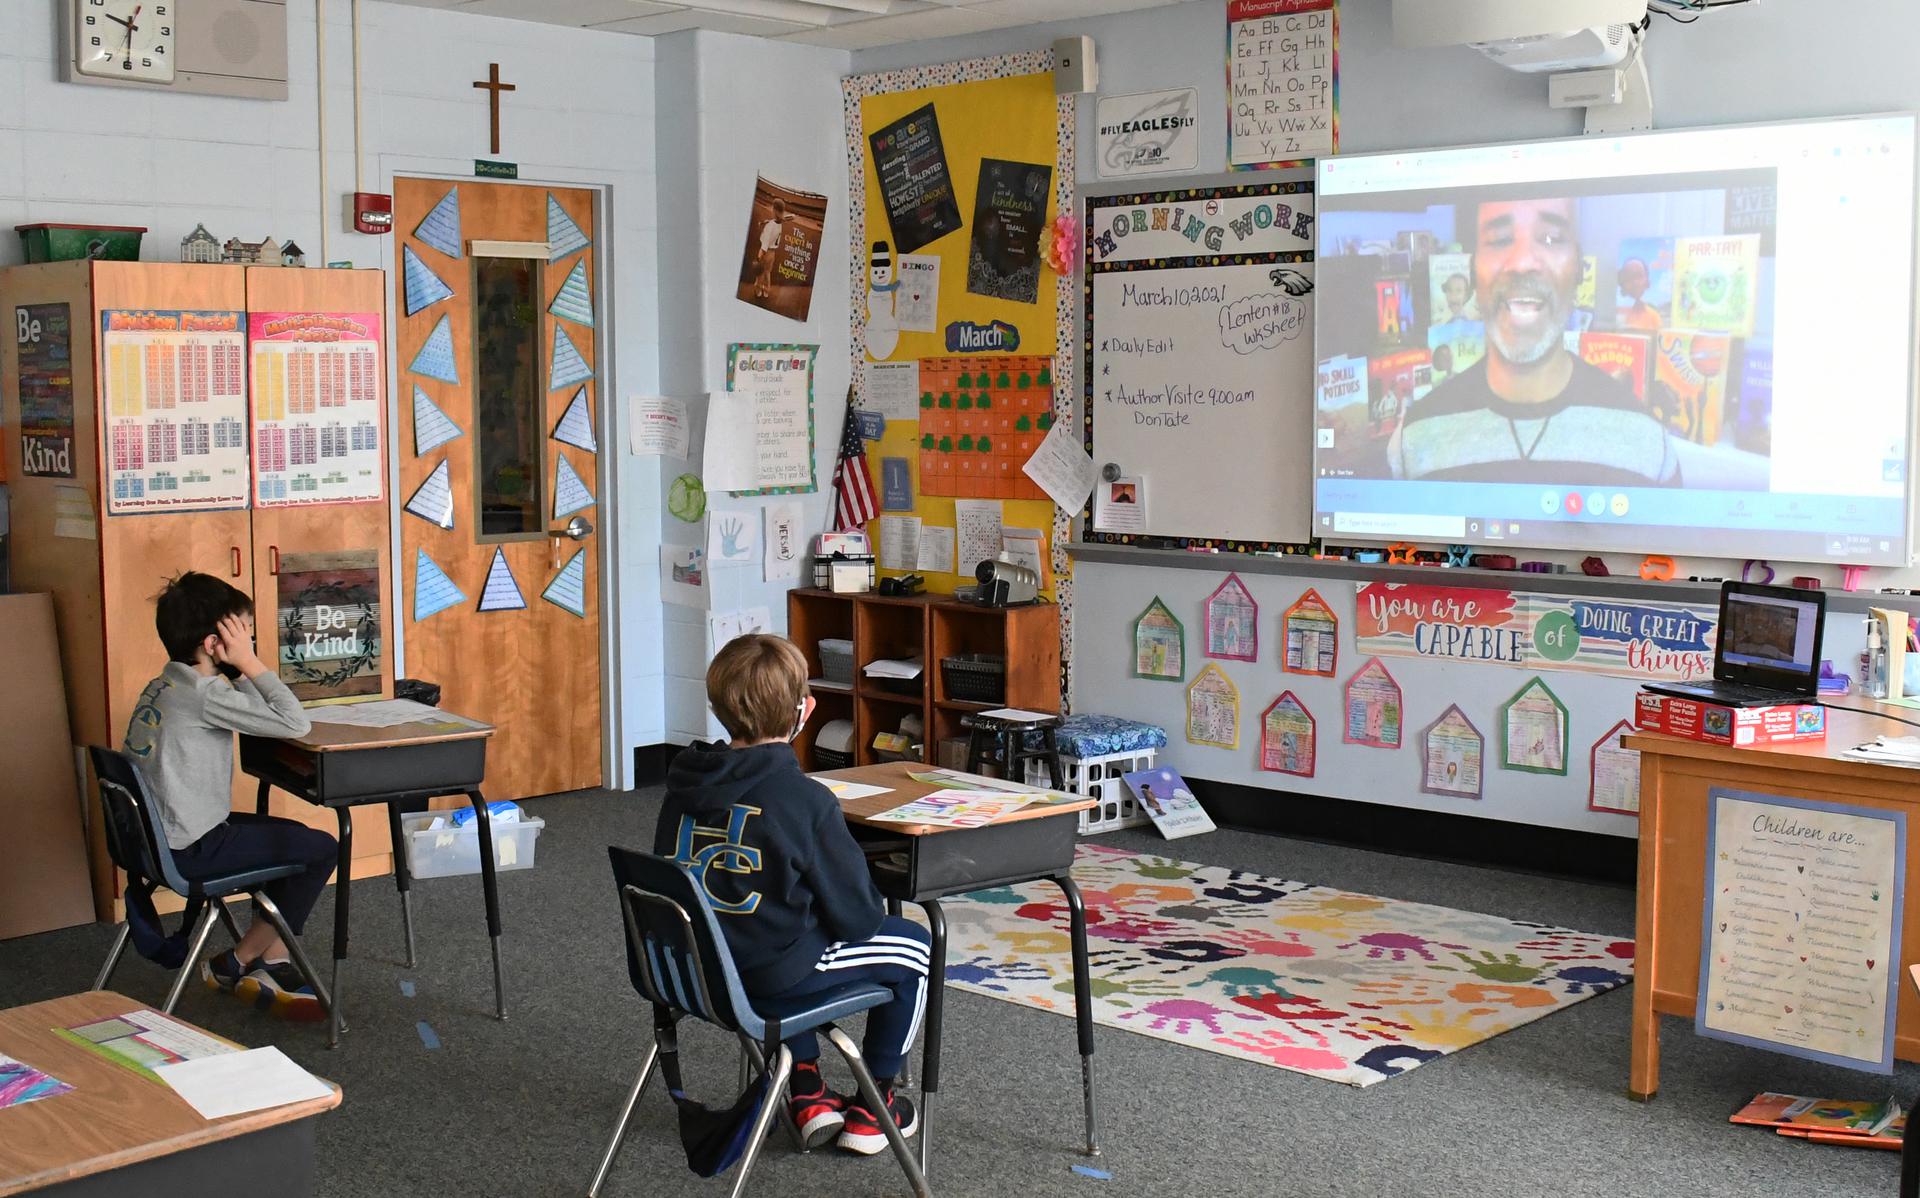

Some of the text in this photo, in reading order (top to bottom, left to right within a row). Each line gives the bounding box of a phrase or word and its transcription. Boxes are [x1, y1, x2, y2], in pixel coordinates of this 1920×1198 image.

[86, 16, 95, 25] 9
[156, 6, 166, 16] 2
[91, 36, 101, 46] 8
[161, 27, 170, 36] 3
[104, 52, 113, 62] 7
[154, 45, 165, 54] 4
[142, 58, 151, 67] 5
[1100, 117, 1194, 135] #FLYEAGLESFLY
[912, 162, 942, 182] TALENTED
[889, 185, 919, 208] HONEST
[785, 234, 806, 247] expert
[1094, 203, 1315, 259] MORNING WORK
[784, 244, 811, 262] anything
[779, 263, 808, 281] beginner
[902, 262, 935, 271] BINGO
[1122, 284, 1172, 306] March
[16, 308, 42, 343] Be
[1228, 304, 1270, 330] Lenten
[959, 324, 1002, 348] March
[1112, 337, 1174, 357] Daily Edit
[775, 356, 806, 371] rules
[1331, 366, 1355, 383] SMALL
[1117, 384, 1164, 405] Author
[1324, 380, 1360, 400] POTATOES
[1134, 410, 1191, 427] Don Tate
[22, 435, 72, 474] Kind
[315, 604, 346, 631] Be
[1369, 593, 1481, 633] You are
[1581, 606, 1700, 643] DOING GREAT
[303, 628, 358, 658] Kind
[1415, 622, 1524, 662] CAPABLE
[1544, 624, 1567, 647] of
[1752, 814, 1826, 841] Children
